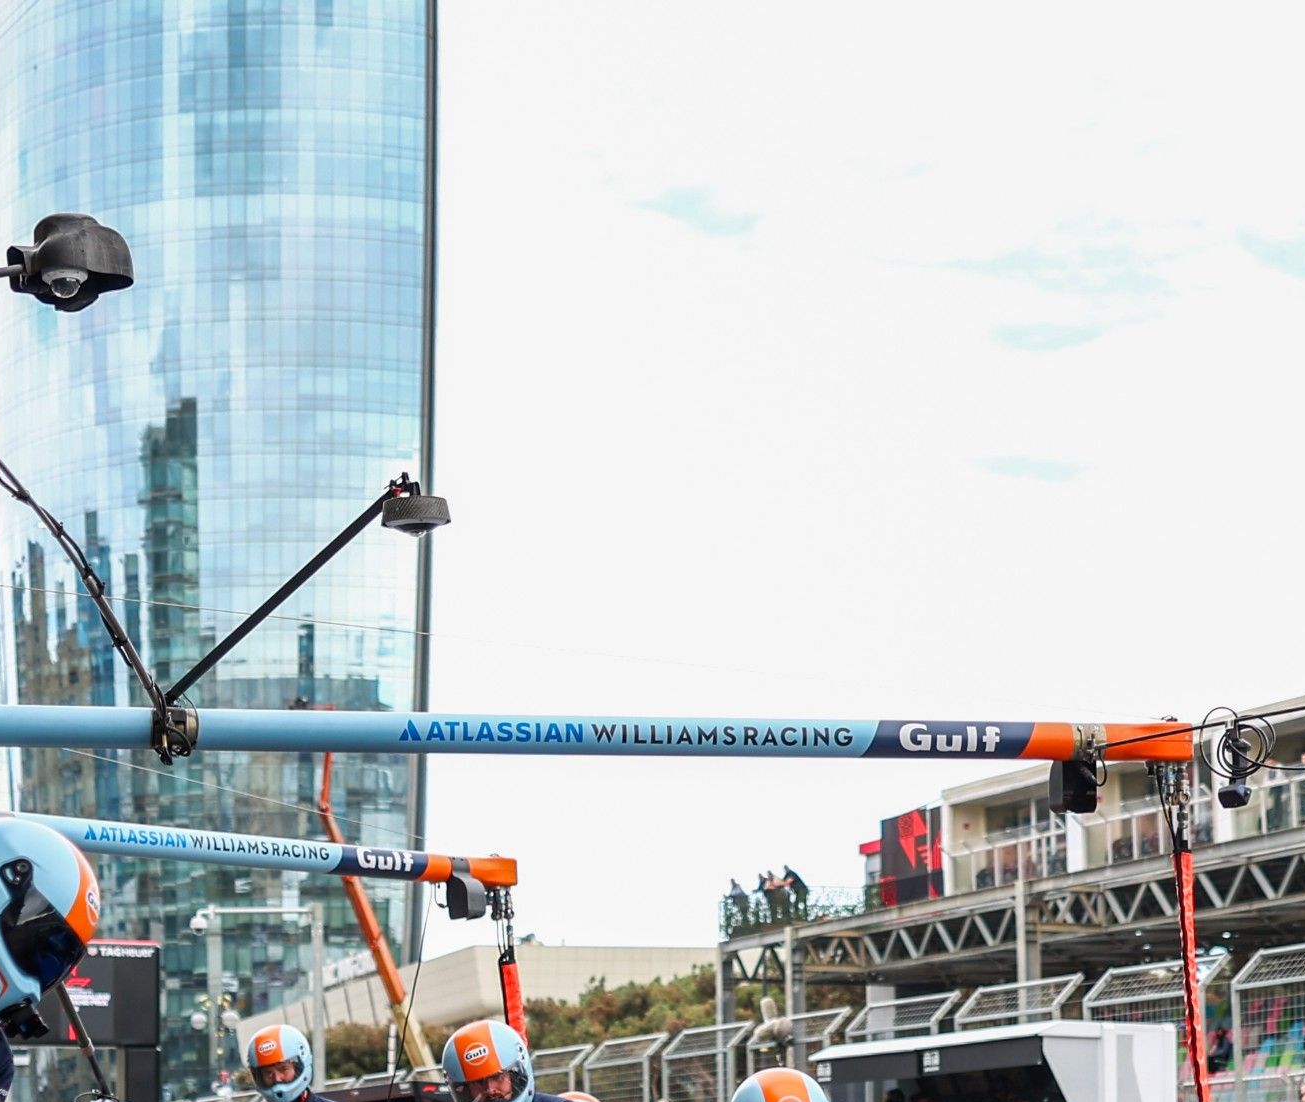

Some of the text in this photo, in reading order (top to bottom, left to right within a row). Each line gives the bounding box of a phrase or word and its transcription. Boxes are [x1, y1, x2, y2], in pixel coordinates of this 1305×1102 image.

[426, 720, 583, 743] ATLASSIAN
[899, 723, 1001, 753] Gulf
[99, 826, 187, 849] ATLASSIAN
[357, 847, 414, 873] Gulf
[465, 1047, 487, 1062] Gulf
